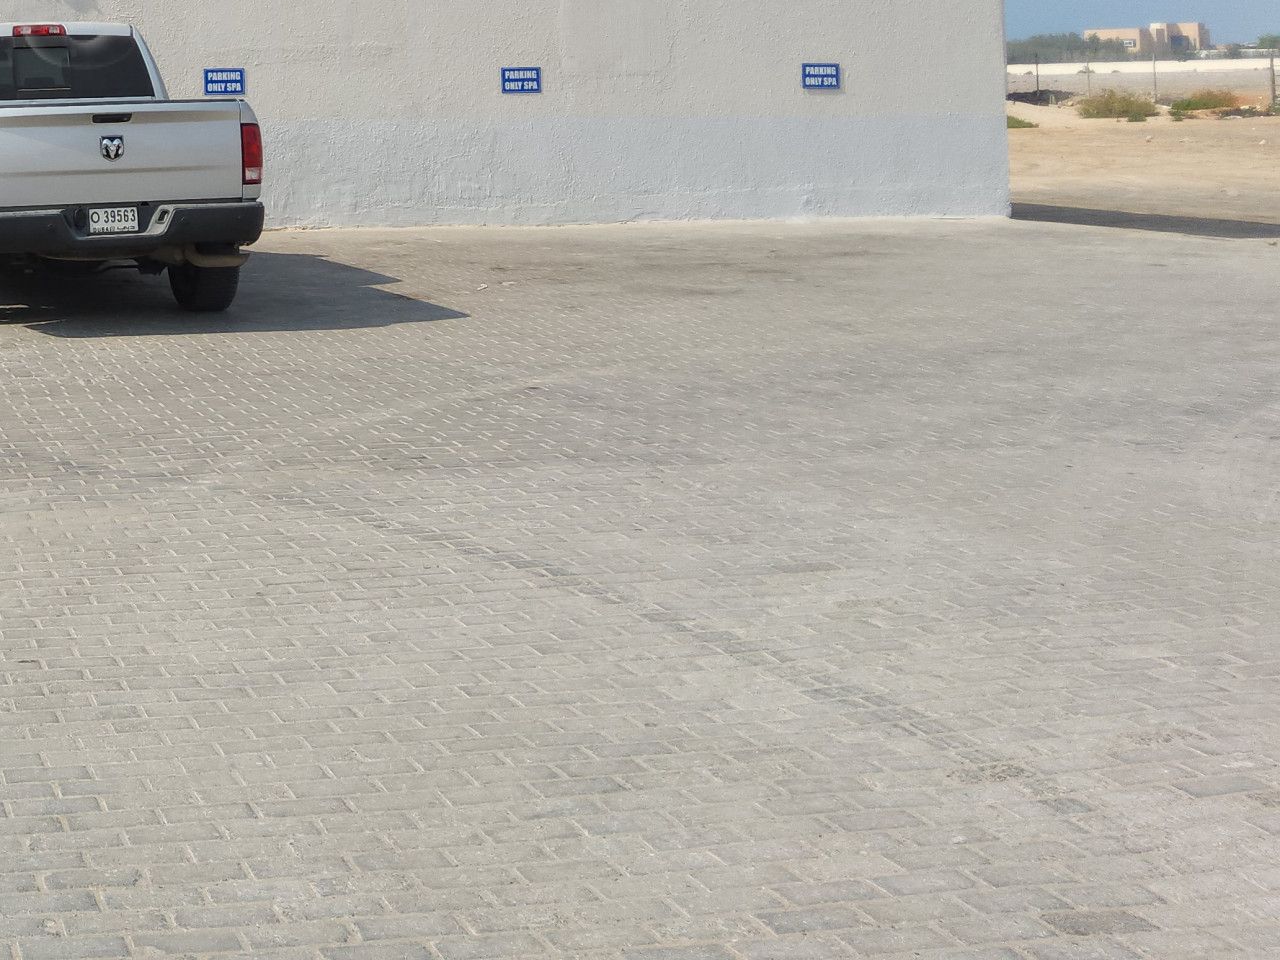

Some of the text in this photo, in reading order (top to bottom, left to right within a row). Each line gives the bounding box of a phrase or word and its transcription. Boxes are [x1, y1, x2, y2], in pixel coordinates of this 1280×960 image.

[504, 70, 538, 79] PARKING
[805, 66, 837, 75] PARKING
[207, 71, 241, 81] PARKING
[504, 81, 538, 90] ONLY SPA
[805, 77, 838, 86] ONLY SPA
[207, 83, 242, 92] ONLY SPA
[103, 208, 136, 223] 39563
